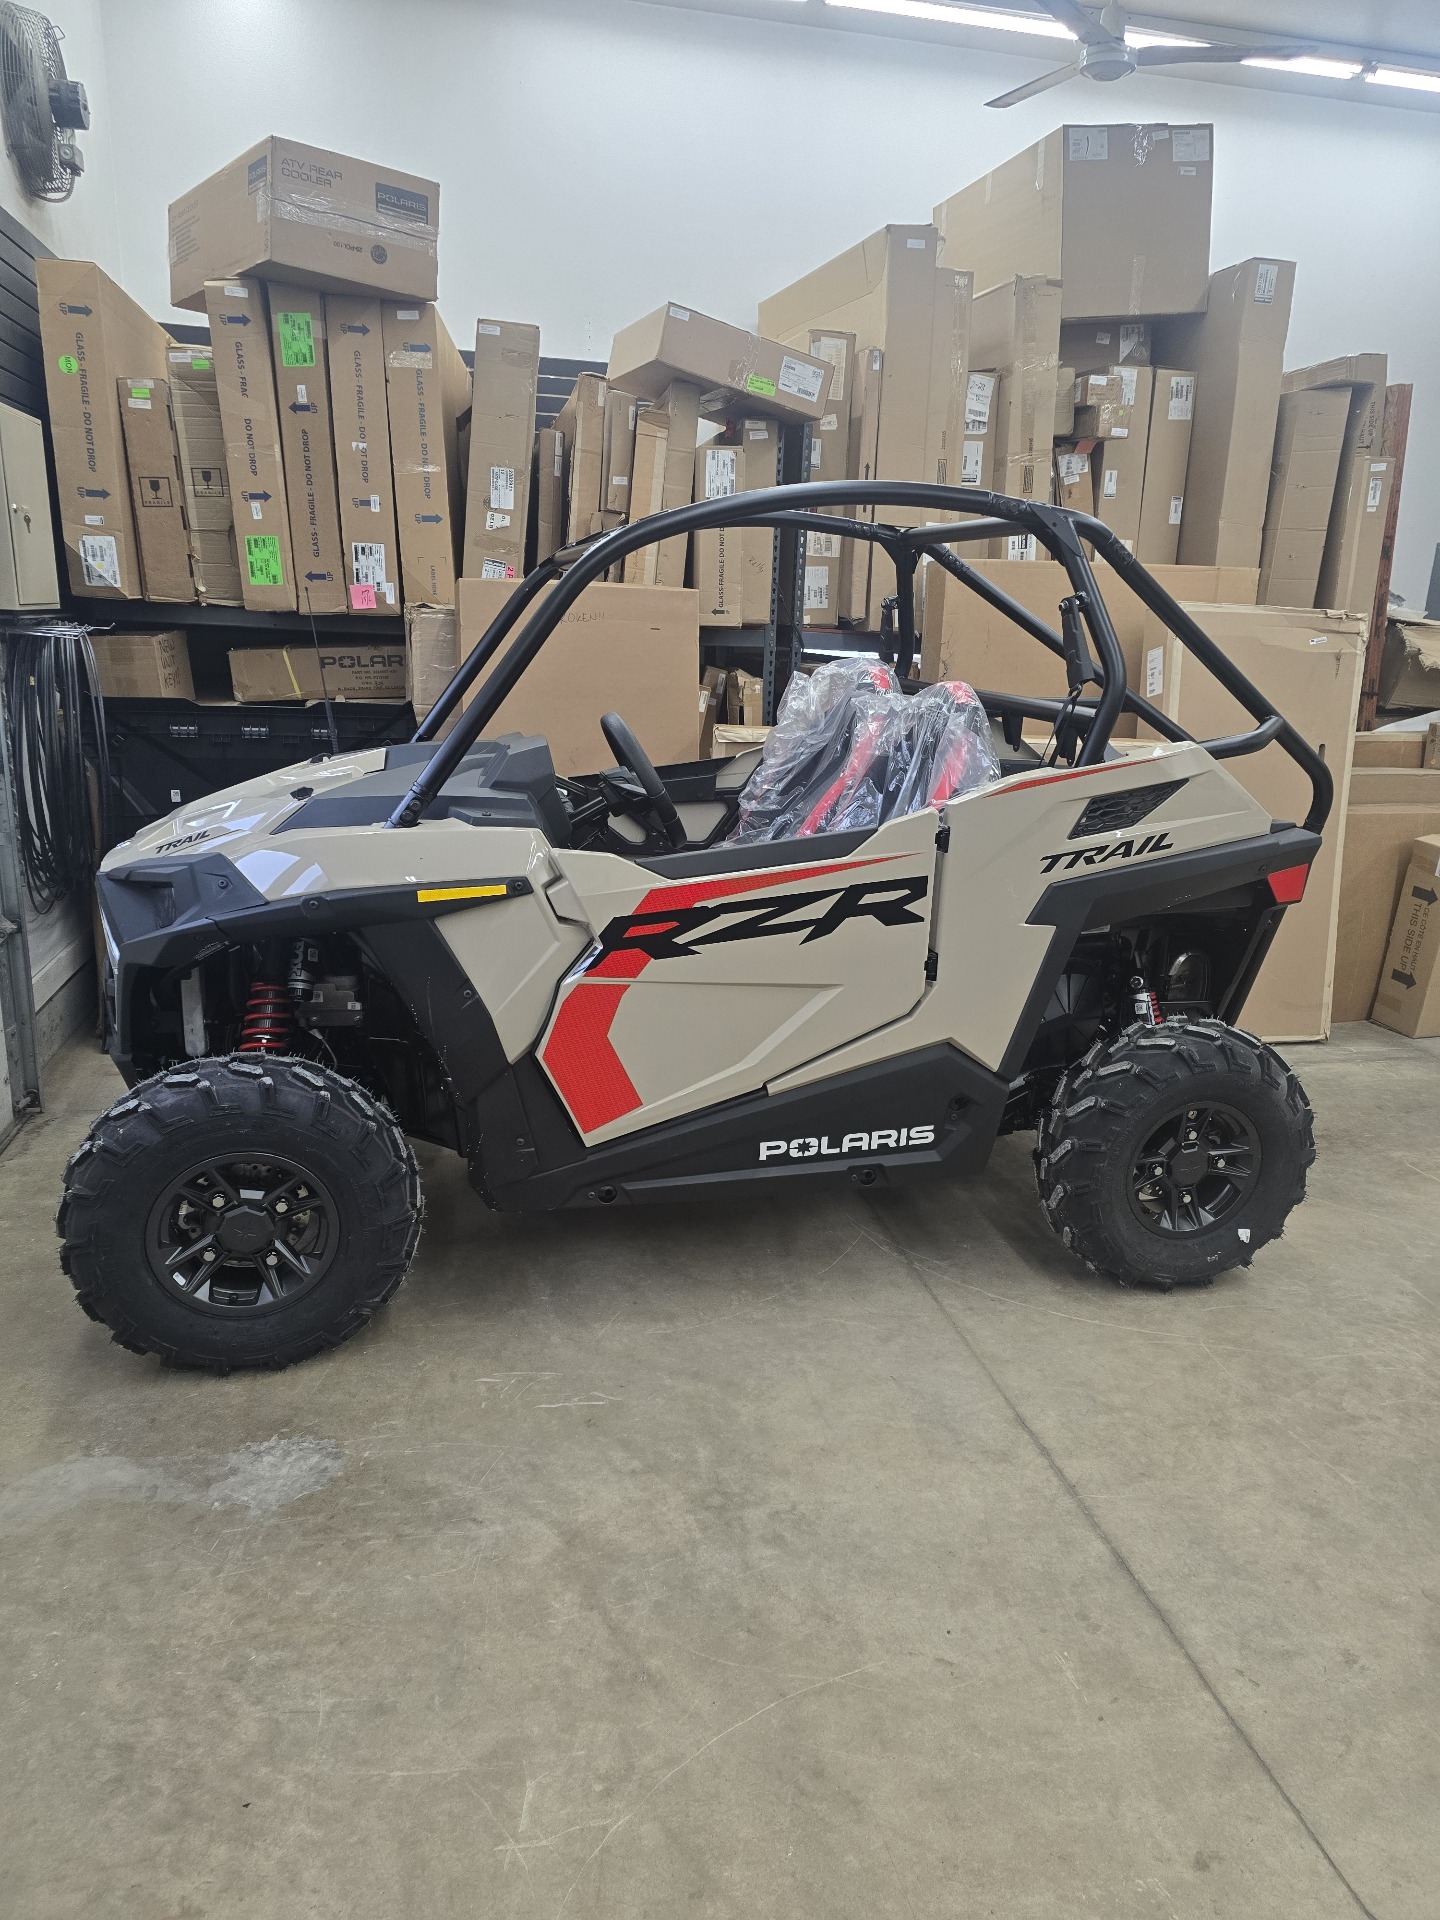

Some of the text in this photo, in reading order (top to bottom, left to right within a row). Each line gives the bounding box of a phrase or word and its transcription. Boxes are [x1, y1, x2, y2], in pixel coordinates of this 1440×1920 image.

[281, 158, 343, 181] ATV REAR
[281, 168, 332, 188] COOLER
[377, 191, 427, 212] POLARIS
[59, 302, 68, 315] UP
[219, 313, 227, 325] UP
[340, 323, 348, 335] UP
[75, 332, 86, 362] GLASS
[235, 341, 245, 370] GLASS
[64, 356, 73, 374] MON
[353, 350, 363, 378] GLASS
[79, 368, 91, 405] FRAGILE
[415, 369, 425, 396] GLASS
[310, 402, 318, 414] UP
[356, 384, 366, 420] FRAGILE
[83, 411, 92, 427] DO
[244, 418, 252, 431] DO
[418, 402, 428, 437] FRAGILE
[85, 427, 95, 446] NOT
[246, 433, 255, 451] NOT
[358, 426, 366, 439] DO
[87, 446, 97, 473] DROP
[420, 443, 429, 456] DO
[249, 452, 258, 477] DROP
[303, 454, 311, 472] NOT
[361, 460, 369, 484] DROP
[305, 472, 313, 486] DO
[423, 475, 431, 499] DROP
[77, 486, 85, 498] UP
[241, 491, 249, 503] UP
[308, 493, 318, 526] FRAGILE
[352, 497, 359, 509] UP
[415, 513, 422, 525] UP
[311, 532, 320, 557] GLASS
[326, 571, 334, 582] UP
[320, 655, 406, 669] POLAR
[156, 829, 210, 854] TRAIL
[1040, 832, 1174, 874] TRAIL
[1423, 907, 1430, 918] CE
[584, 875, 929, 972] RZR
[1400, 903, 1422, 971] THIS SIDE UP
[1415, 940, 1422, 952] EN
[290, 940, 305, 977] FOX
[1409, 952, 1419, 972] HAUT
[758, 1124, 936, 1162] POLARIS
